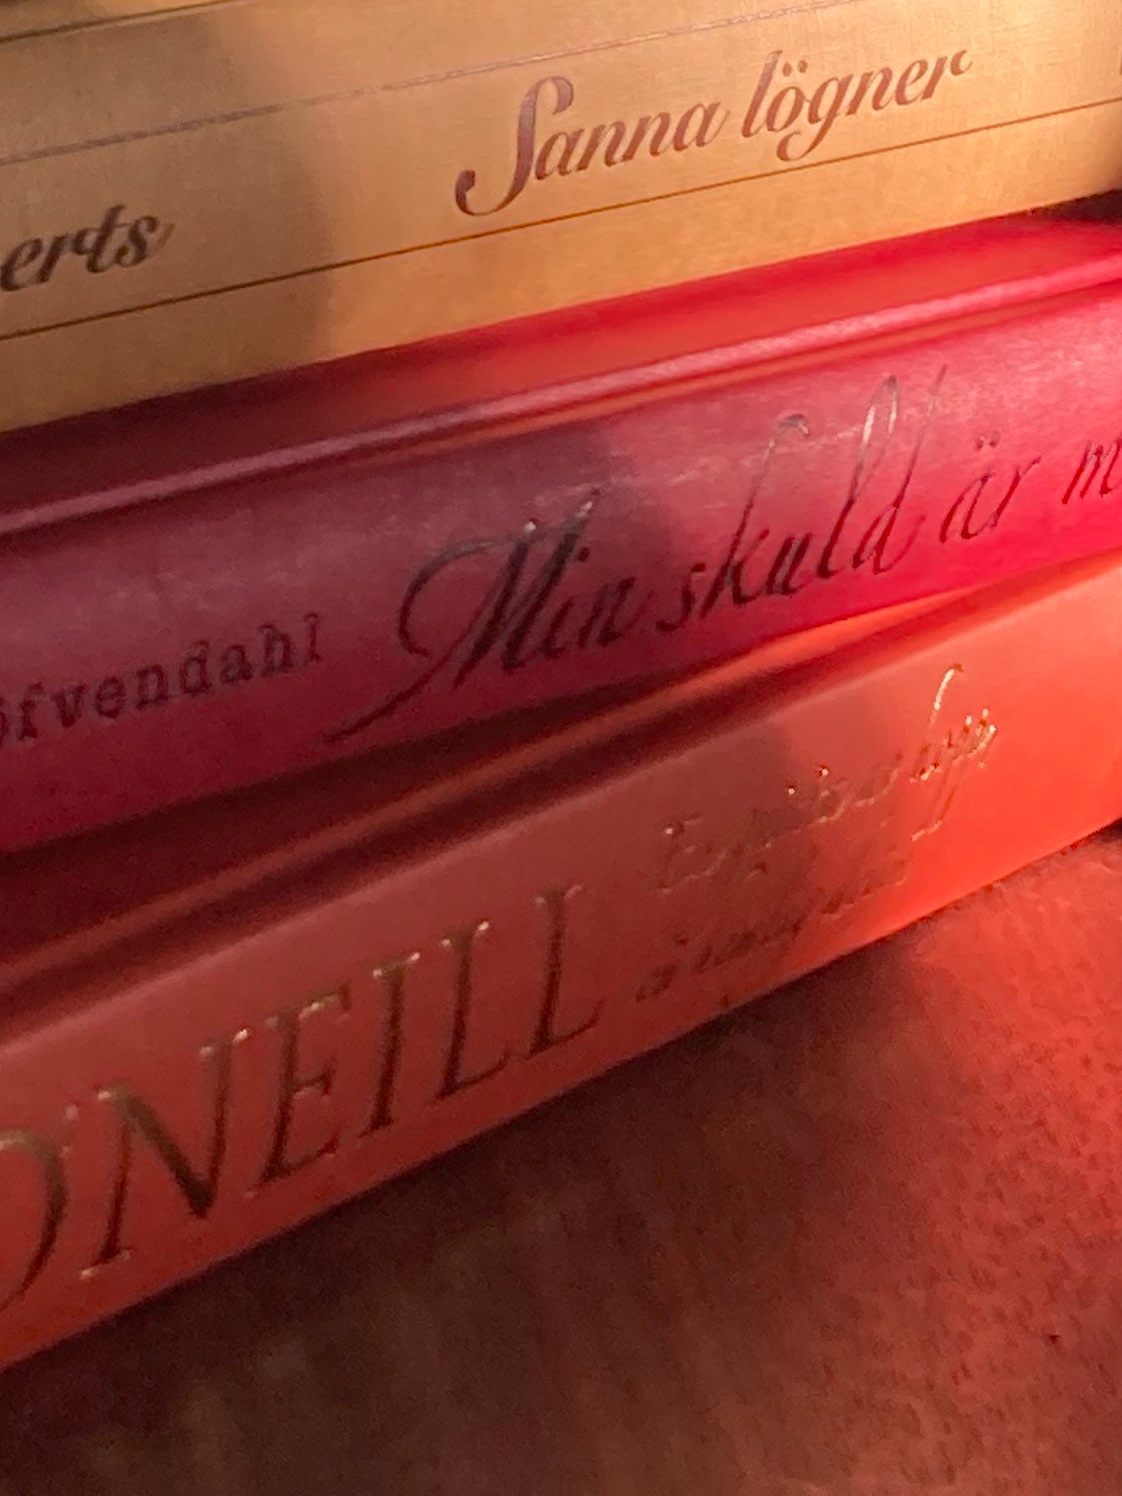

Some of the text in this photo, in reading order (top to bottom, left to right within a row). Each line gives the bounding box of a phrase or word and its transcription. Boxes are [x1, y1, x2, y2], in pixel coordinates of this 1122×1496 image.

[454, 48, 973, 218] Sanna lögner
[323, 488, 654, 745] Min
[656, 363, 950, 633] skuld
[938, 431, 1042, 544] är
